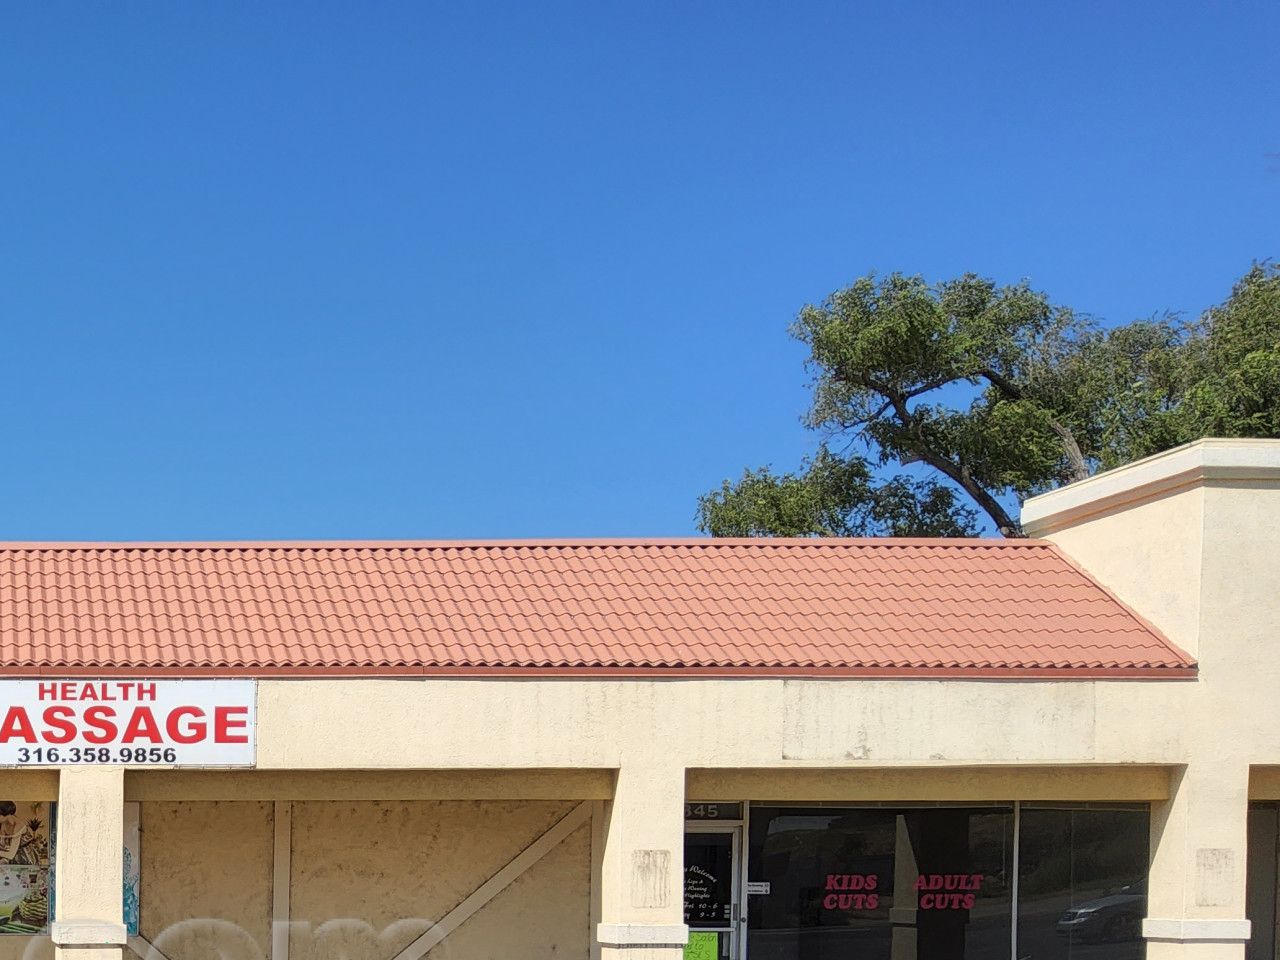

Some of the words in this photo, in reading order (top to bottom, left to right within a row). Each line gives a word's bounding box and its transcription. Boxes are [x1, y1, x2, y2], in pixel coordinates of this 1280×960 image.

[37, 682, 156, 701] HEALTH
[17, 747, 177, 763] 316.358.9856
[684, 804, 718, 817] 345
[825, 874, 878, 890] KIDS
[912, 874, 984, 890] ADULT
[823, 893, 879, 910] CUTS
[920, 893, 977, 910] CUTS
